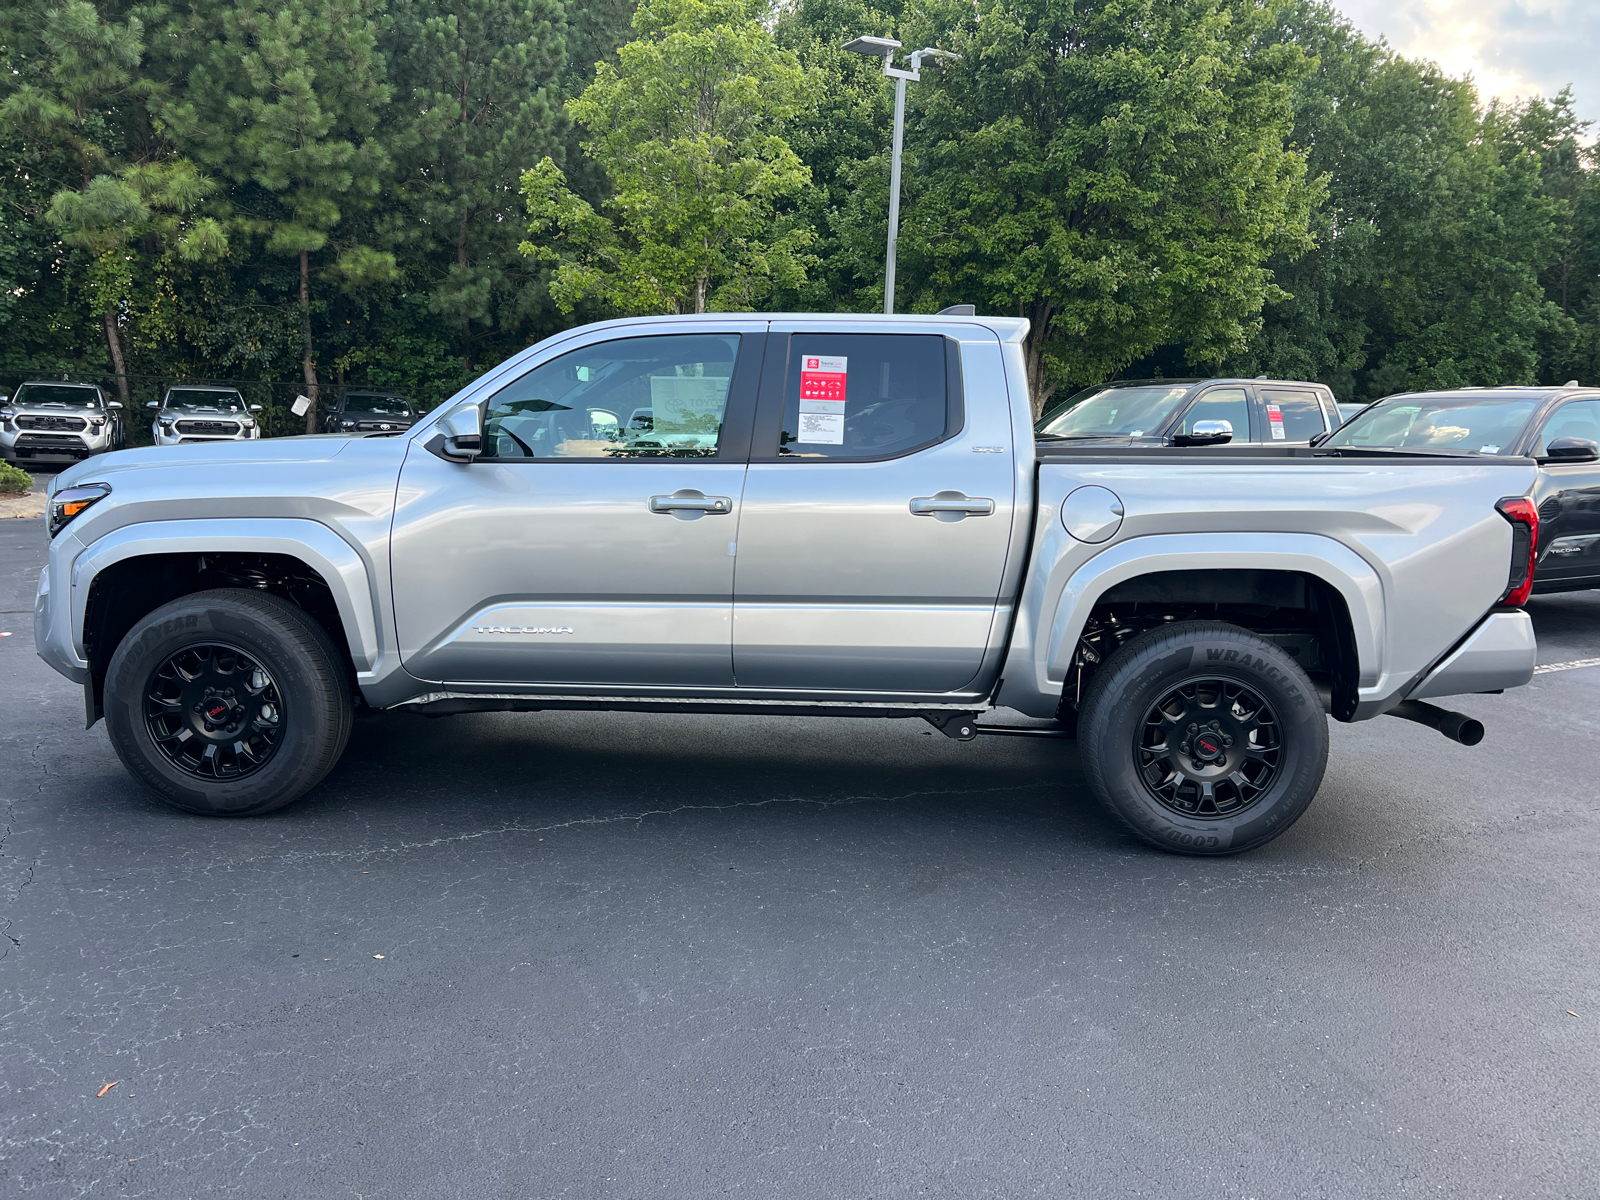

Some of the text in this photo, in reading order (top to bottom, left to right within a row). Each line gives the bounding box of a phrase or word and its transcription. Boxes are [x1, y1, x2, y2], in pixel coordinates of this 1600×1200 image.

[115, 614, 198, 687] GOODYEAR
[472, 626, 573, 634] TACOMA
[1206, 648, 1306, 707] WRANGLER
[1200, 740, 1217, 752] TRD
[128, 752, 177, 796] TERRITORY
[1117, 788, 1219, 848] GOODYEAR
